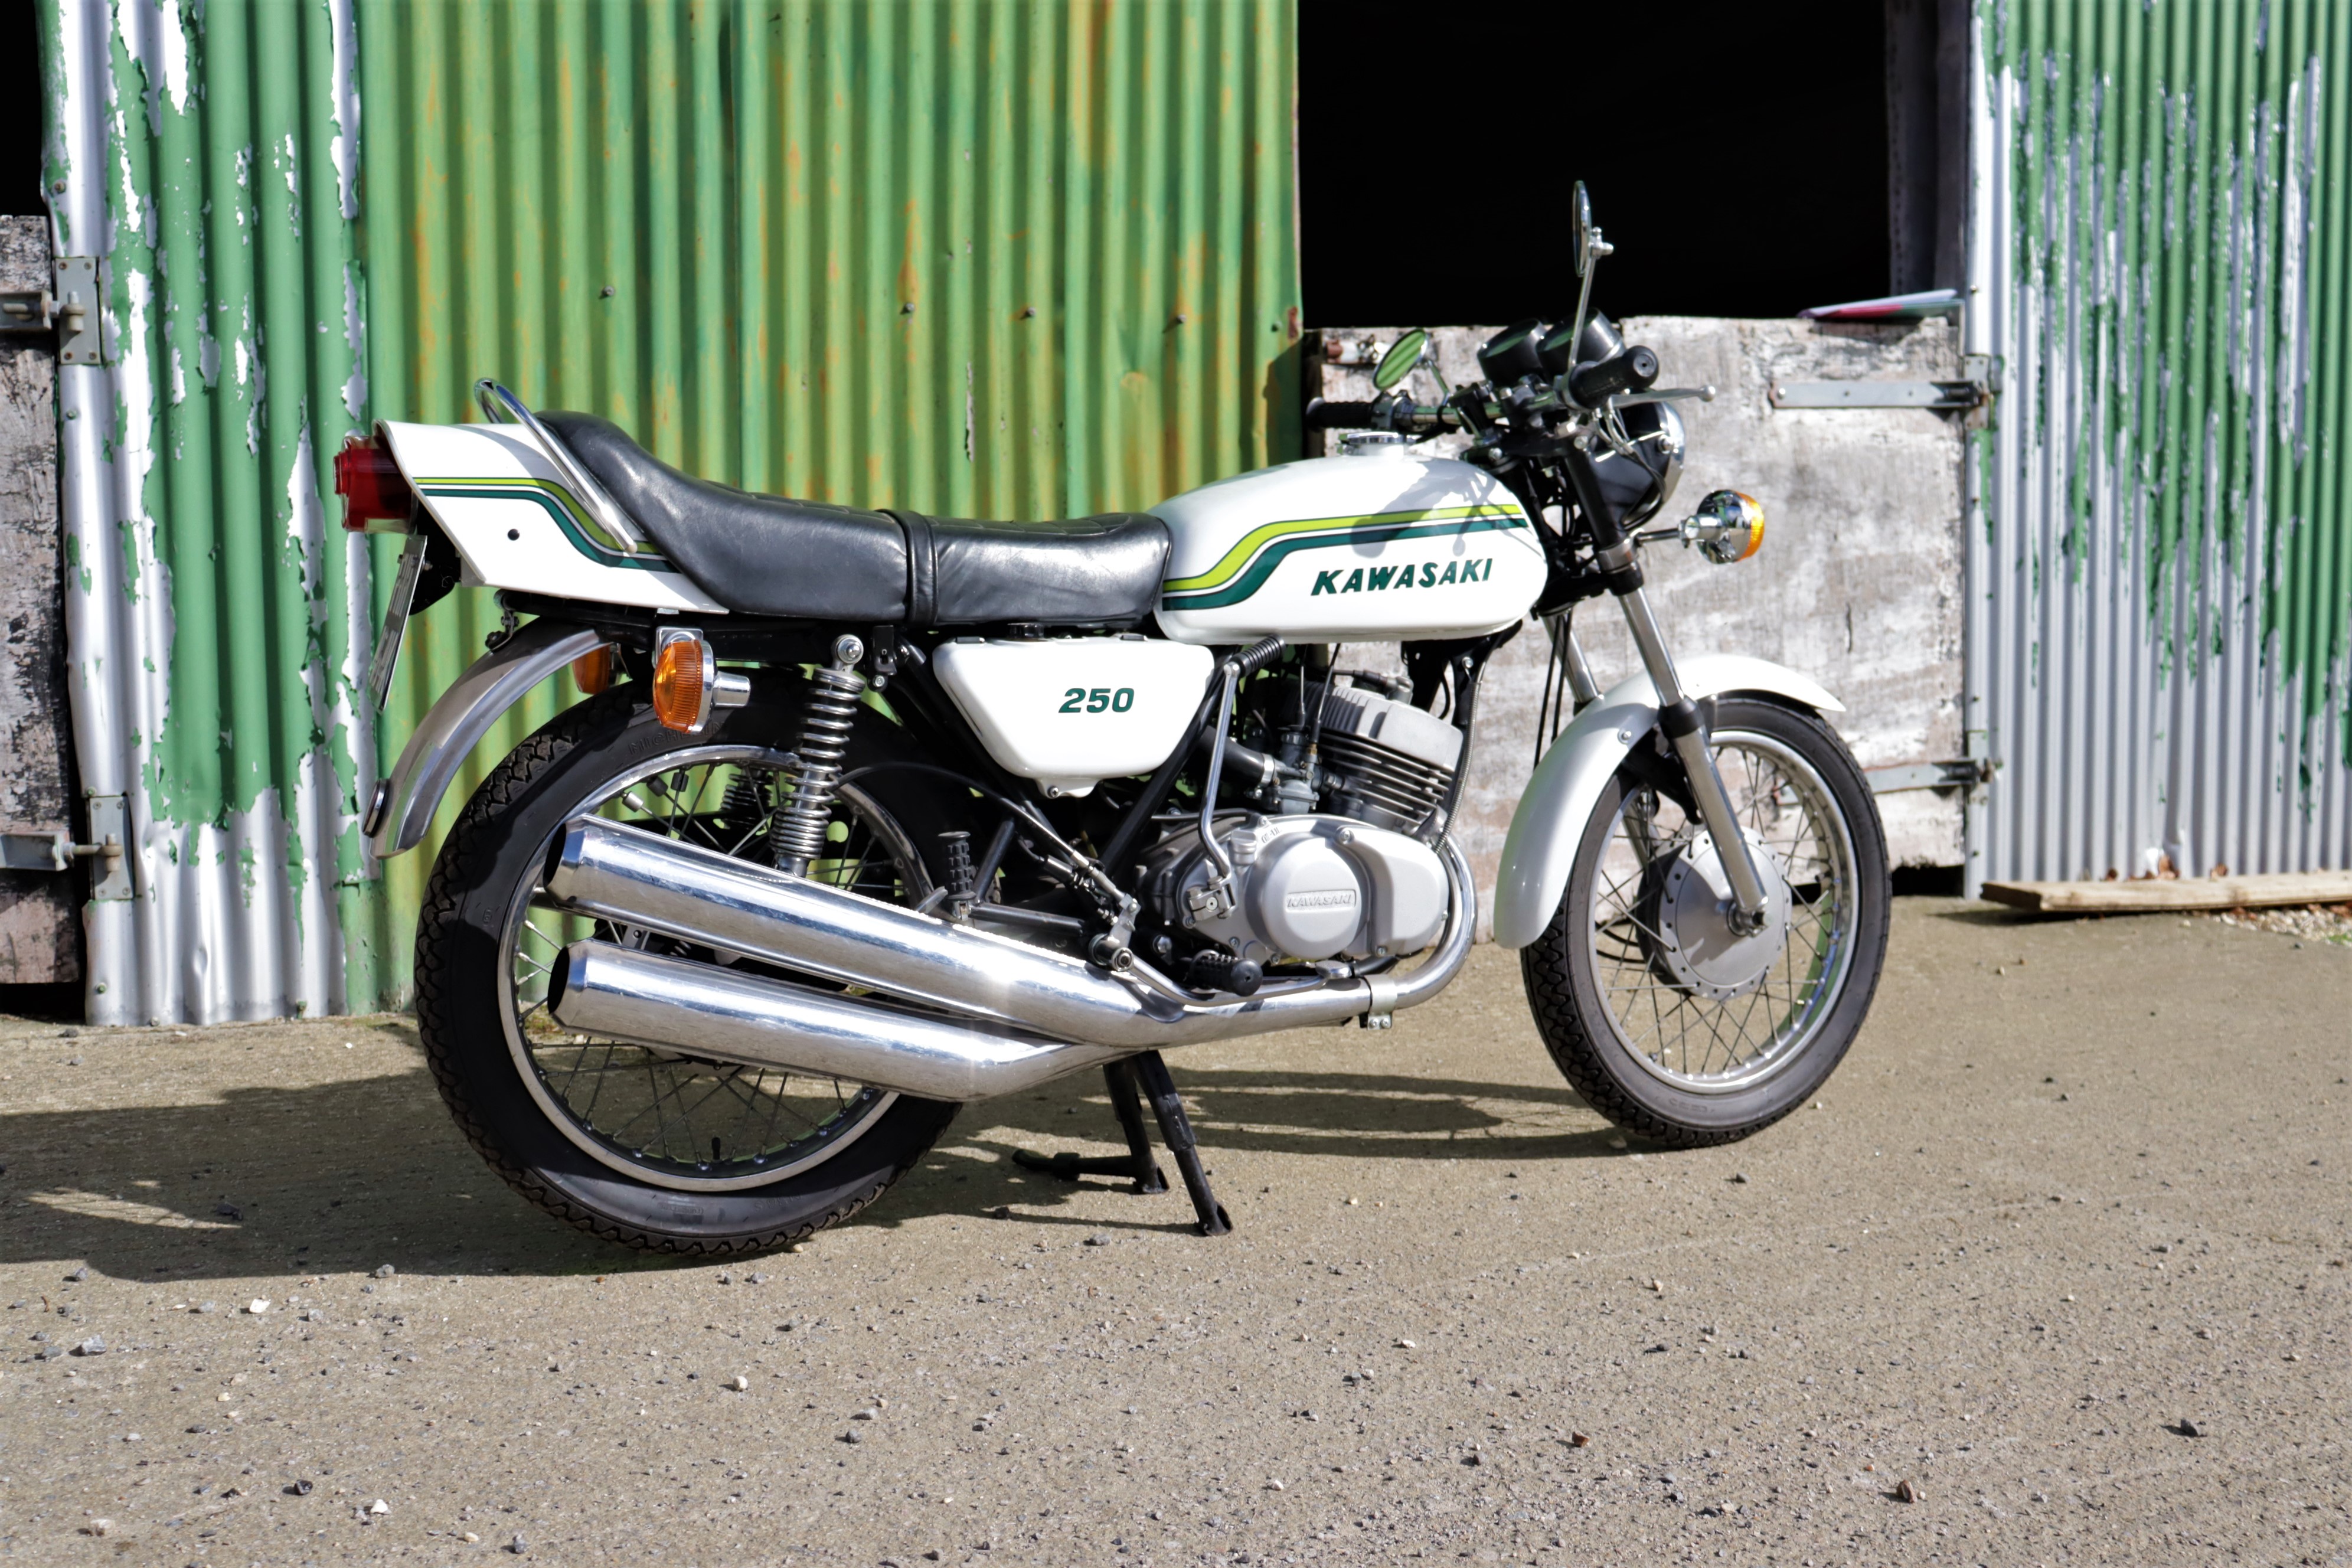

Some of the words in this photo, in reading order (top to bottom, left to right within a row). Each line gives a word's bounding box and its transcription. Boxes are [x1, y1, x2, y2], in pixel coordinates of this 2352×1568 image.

[1311, 558, 1492, 595] KAWASAKI
[1058, 688, 1135, 713] 250
[628, 721, 724, 755] MICHIN
[1287, 894, 1351, 907] KAWASAKI
